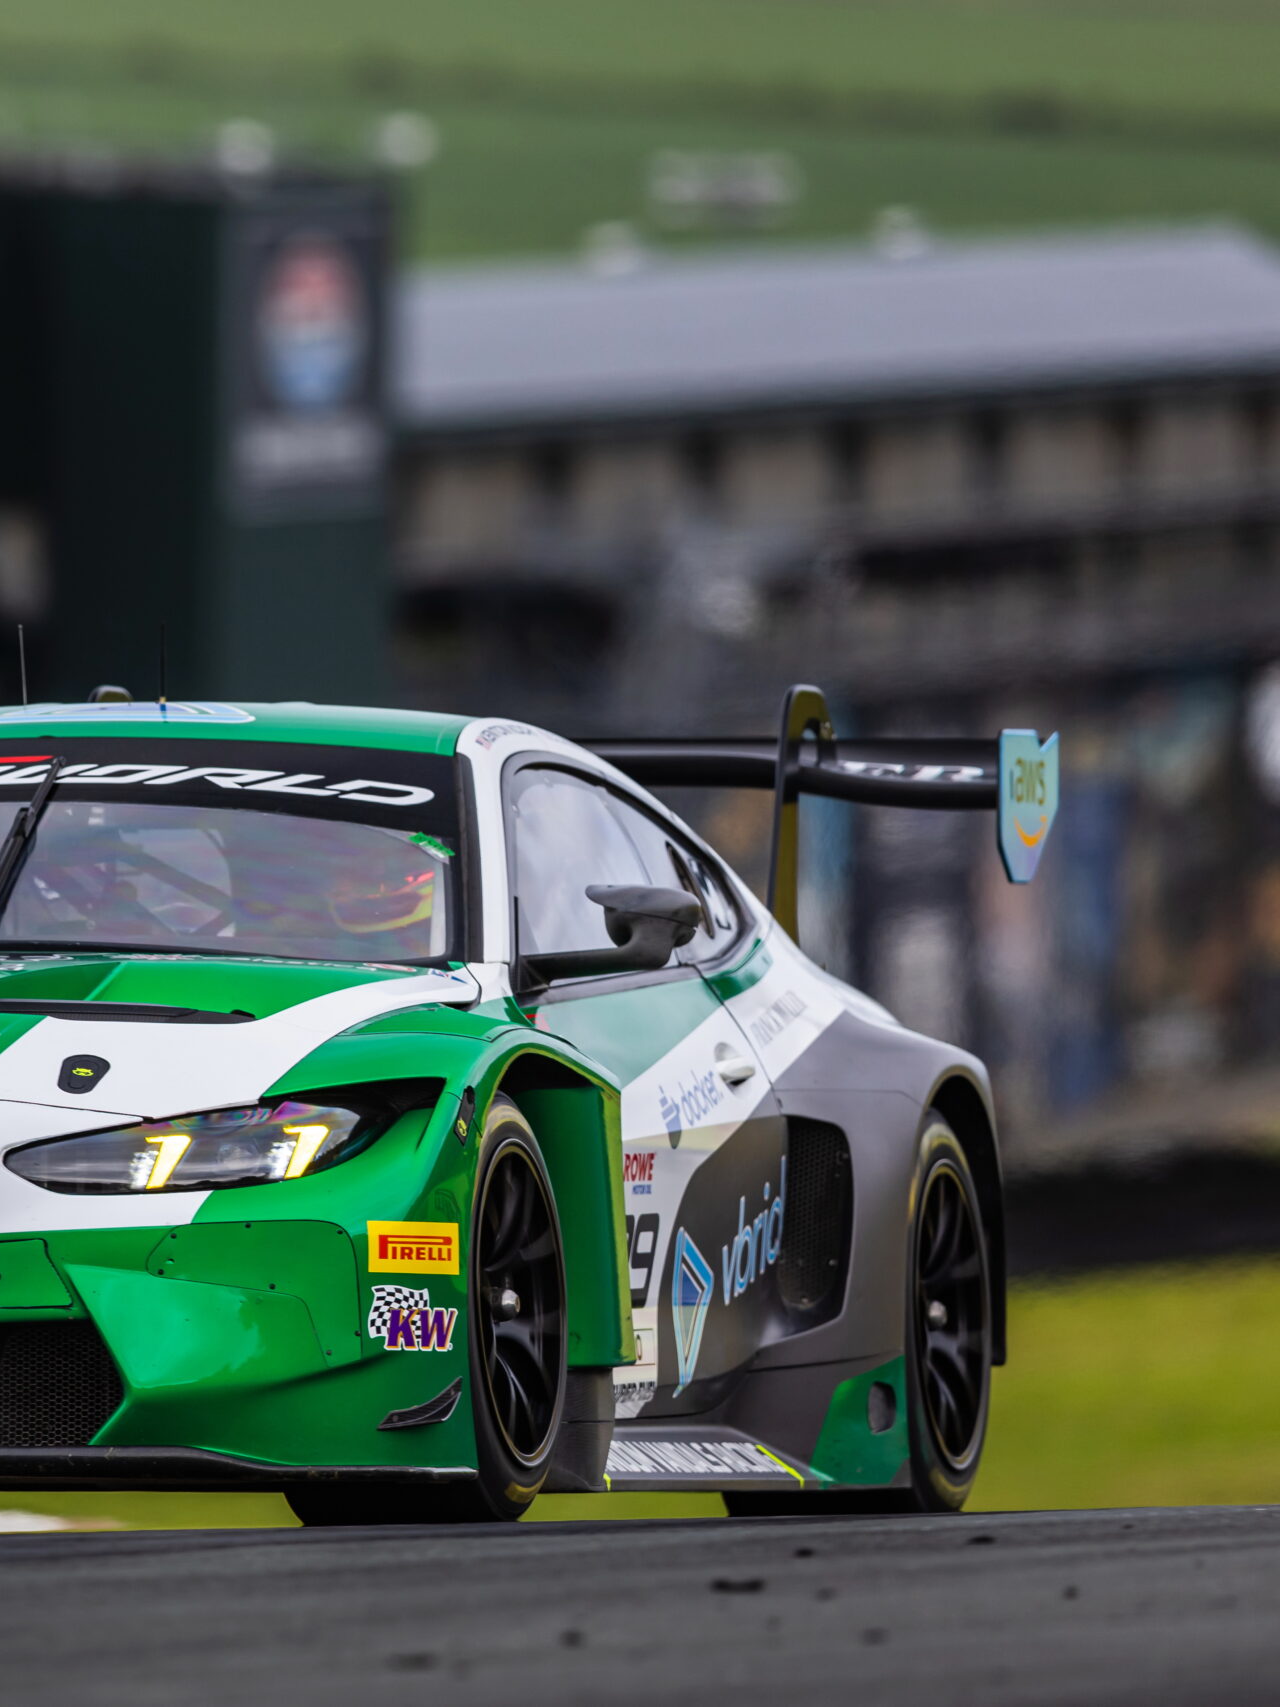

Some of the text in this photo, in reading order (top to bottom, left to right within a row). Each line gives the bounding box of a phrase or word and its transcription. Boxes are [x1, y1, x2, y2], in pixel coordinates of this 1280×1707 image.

[1016, 757, 1046, 806] aws
[622, 1152, 655, 1182] ROWE
[378, 1234, 453, 1261] PIRELLI
[386, 1307, 458, 1351] KW
